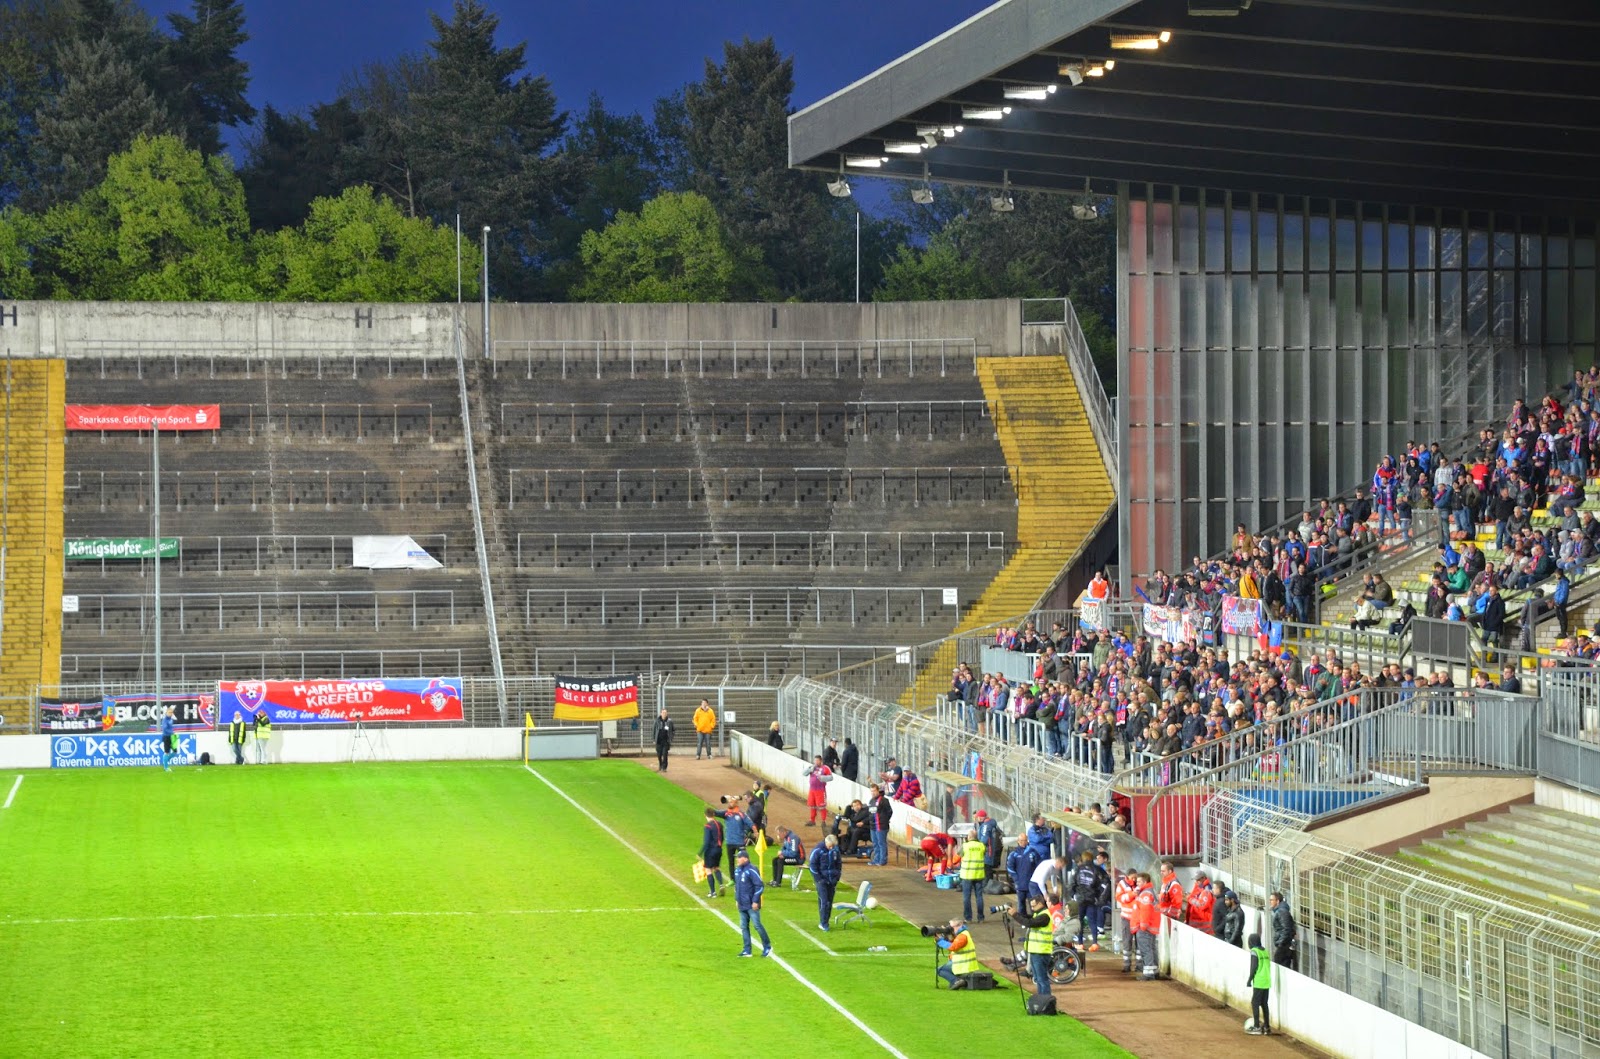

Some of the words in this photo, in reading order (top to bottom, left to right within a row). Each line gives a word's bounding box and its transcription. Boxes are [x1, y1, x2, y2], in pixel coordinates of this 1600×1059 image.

[79, 415, 121, 425] Sparkasse.
[123, 415, 136, 424] Gut
[139, 415, 150, 424] für
[168, 415, 192, 425] Sport.
[67, 540, 141, 557] Königshofer
[293, 681, 385, 696] HARLEKINS
[305, 691, 373, 708] KREFELD
[183, 704, 198, 720] H
[275, 710, 297, 719] 1905
[318, 708, 348, 720] Blut,
[368, 704, 411, 717] Herzen!
[50, 720, 86, 730] BLOCK
[55, 756, 92, 767] Taverne
[94, 756, 105, 766] im
[107, 756, 160, 766] Grossmarkt
